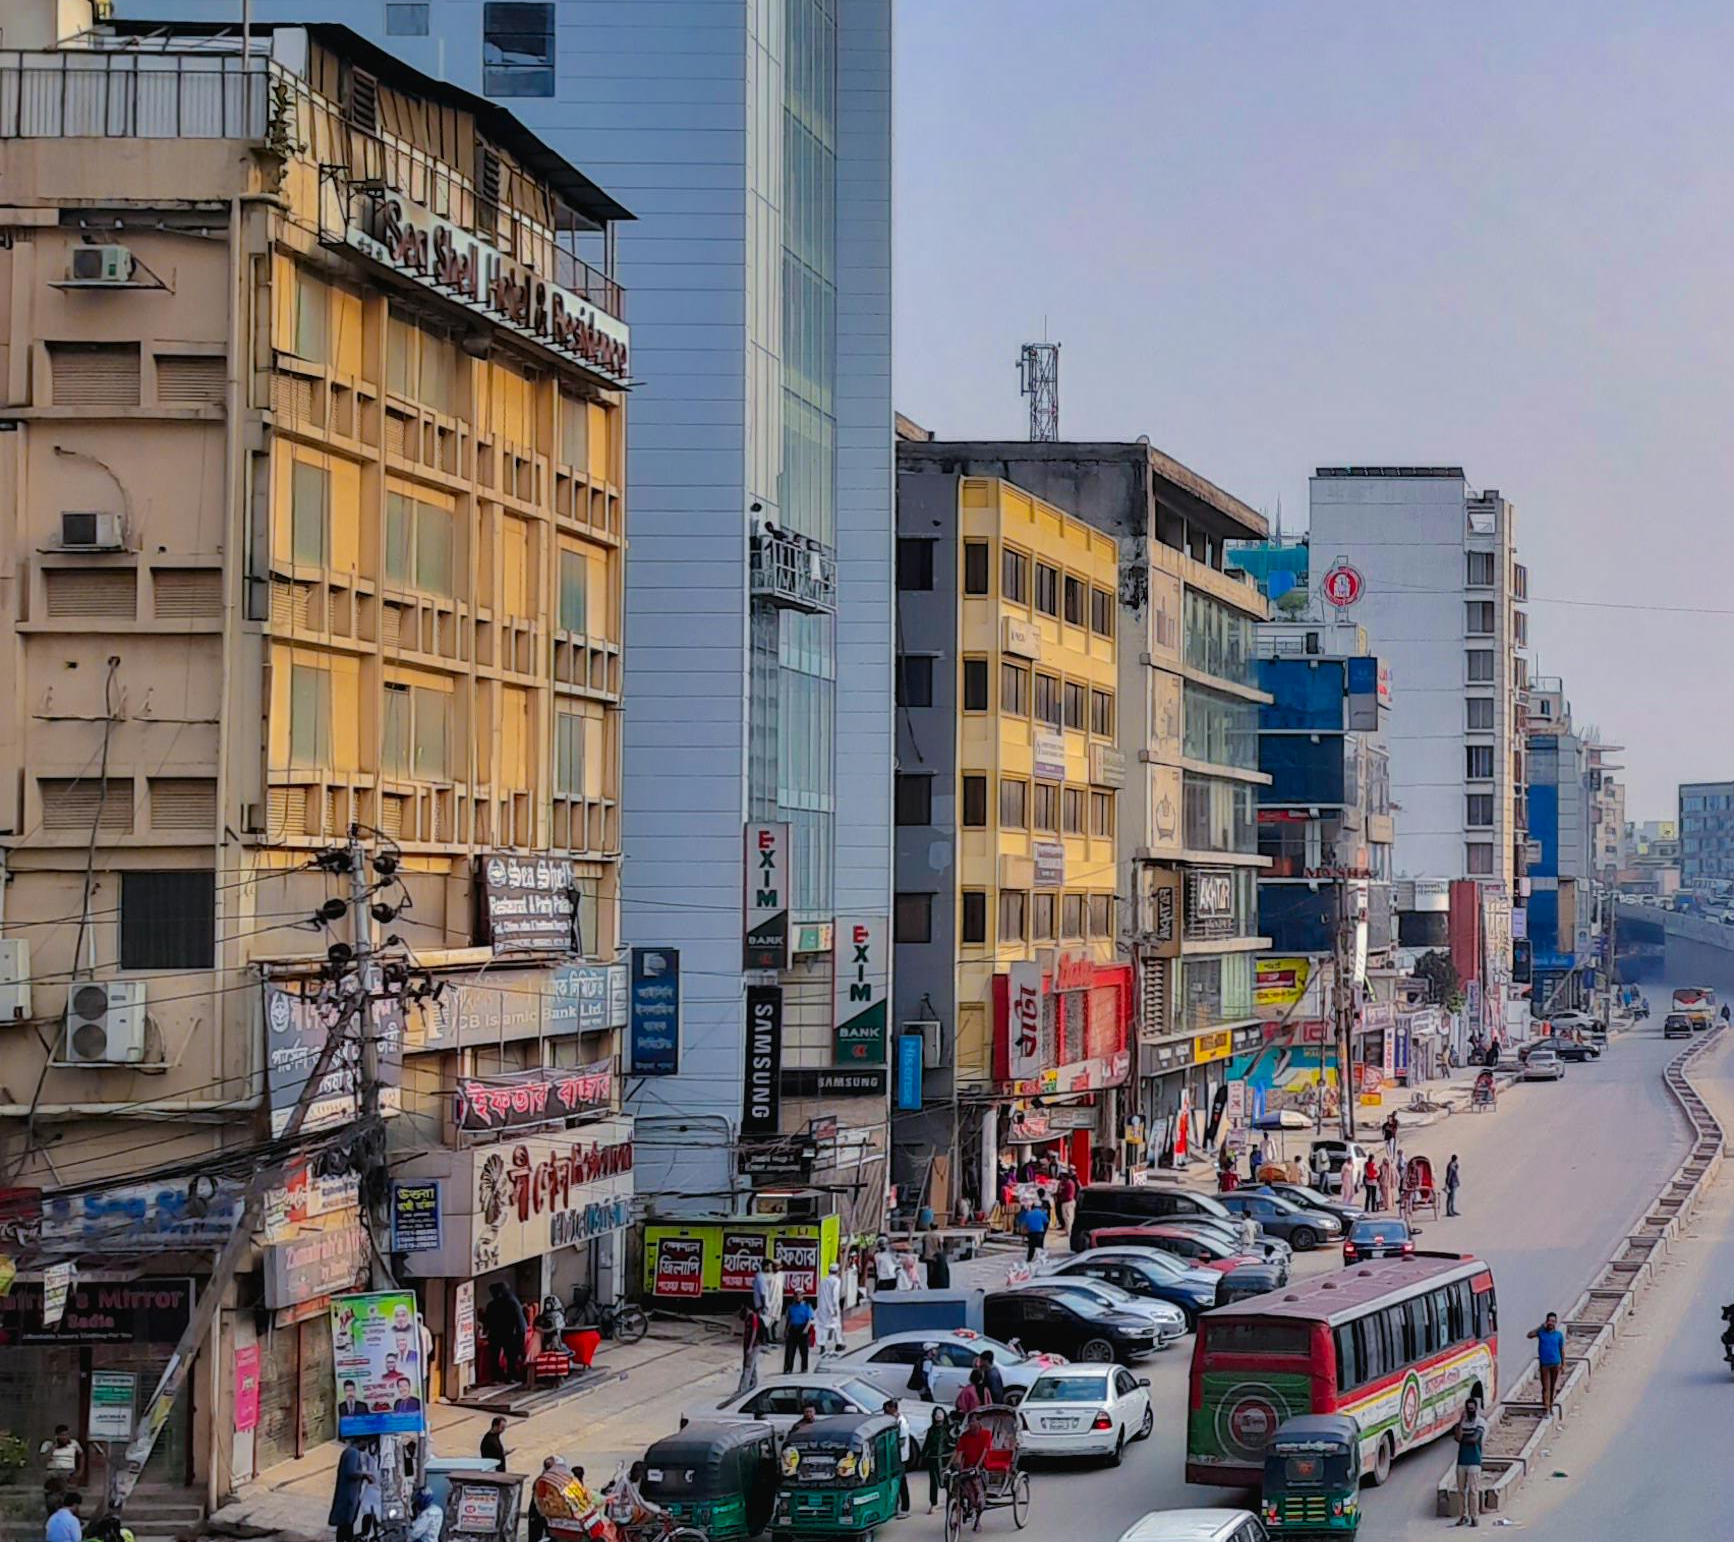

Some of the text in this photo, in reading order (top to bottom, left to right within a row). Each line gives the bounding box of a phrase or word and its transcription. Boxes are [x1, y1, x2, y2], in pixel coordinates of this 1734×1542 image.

[757, 830, 778, 908] EXIM
[749, 936, 783, 946] BANK
[850, 925, 872, 1002] EXIM
[485, 1009, 536, 1029] Isamic
[840, 1027, 880, 1038] BANK
[752, 1004, 775, 1119] SAMSUNG
[784, 1271, 814, 1291] াজার
